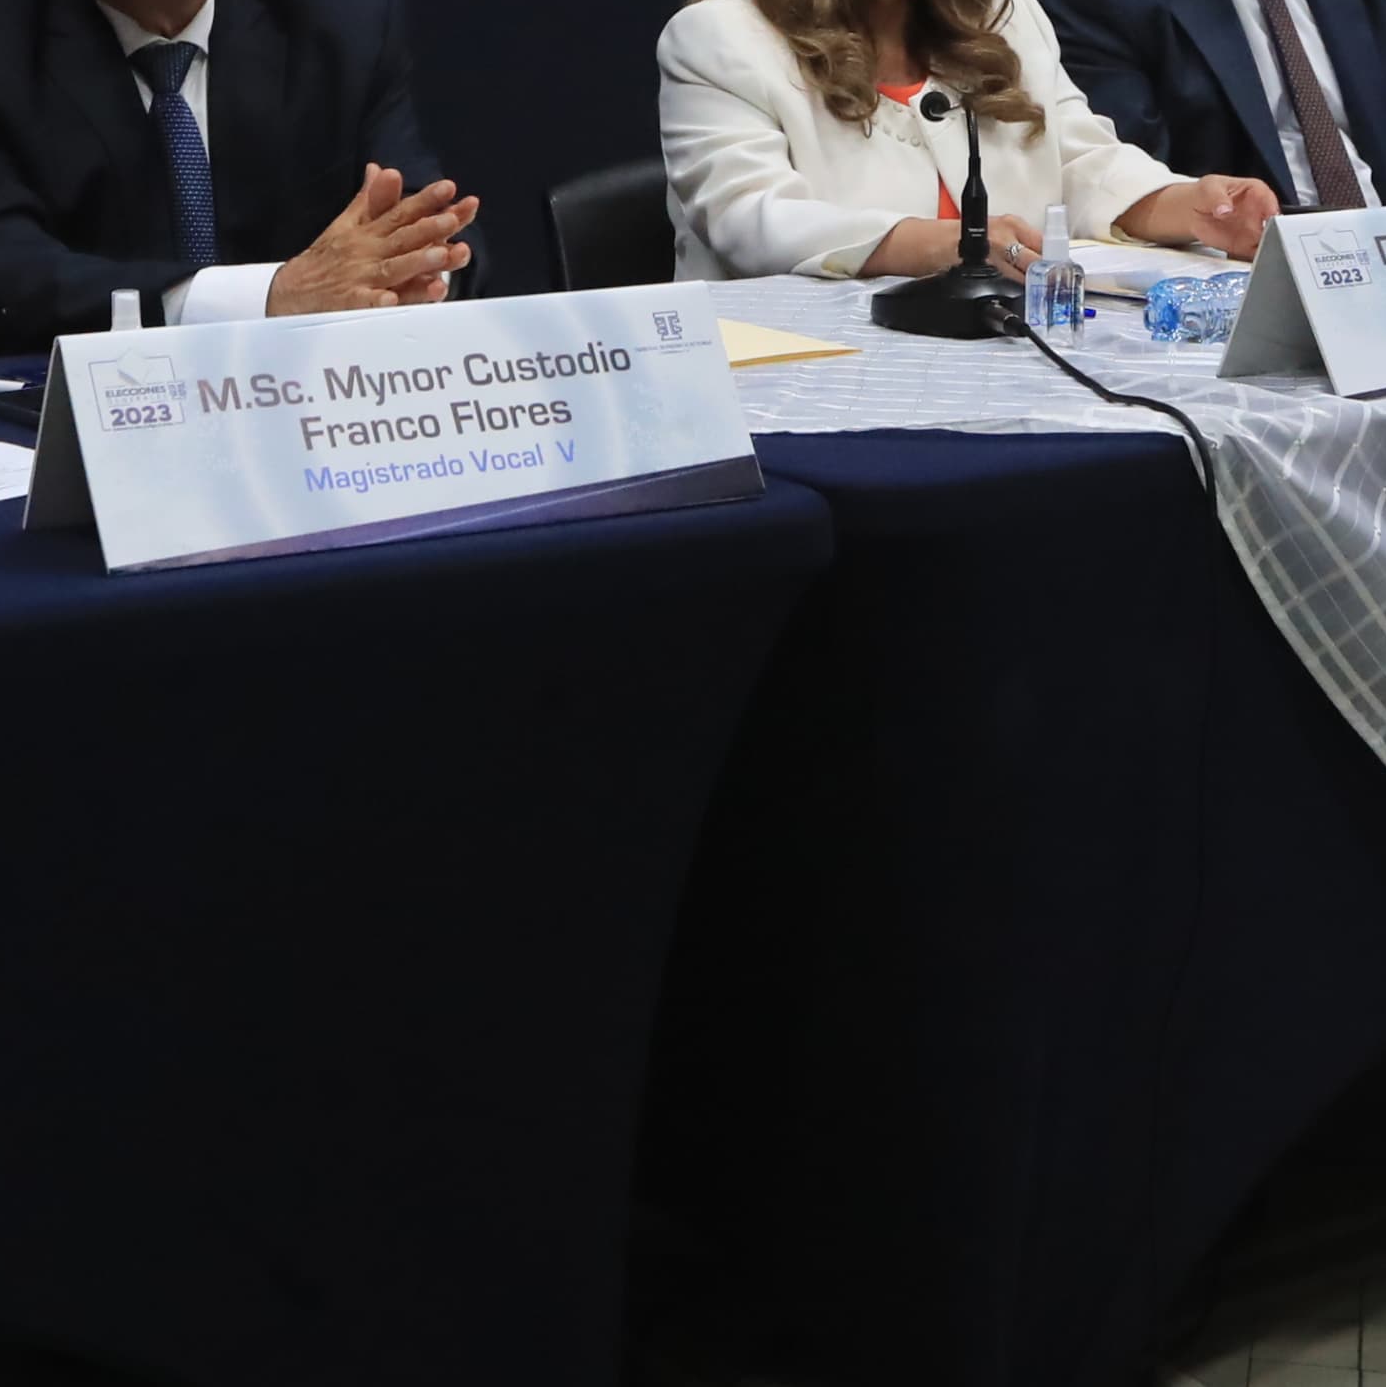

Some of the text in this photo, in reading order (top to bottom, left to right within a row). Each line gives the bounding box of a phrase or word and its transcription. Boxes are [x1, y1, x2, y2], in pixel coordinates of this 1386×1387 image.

[1320, 268, 1364, 286] 2023
[196, 341, 631, 413] M.Sc. Mynor Custodio
[110, 404, 173, 427] 2023
[299, 399, 573, 451] Franco Flores
[304, 438, 575, 494] Magistrado Vocal V
